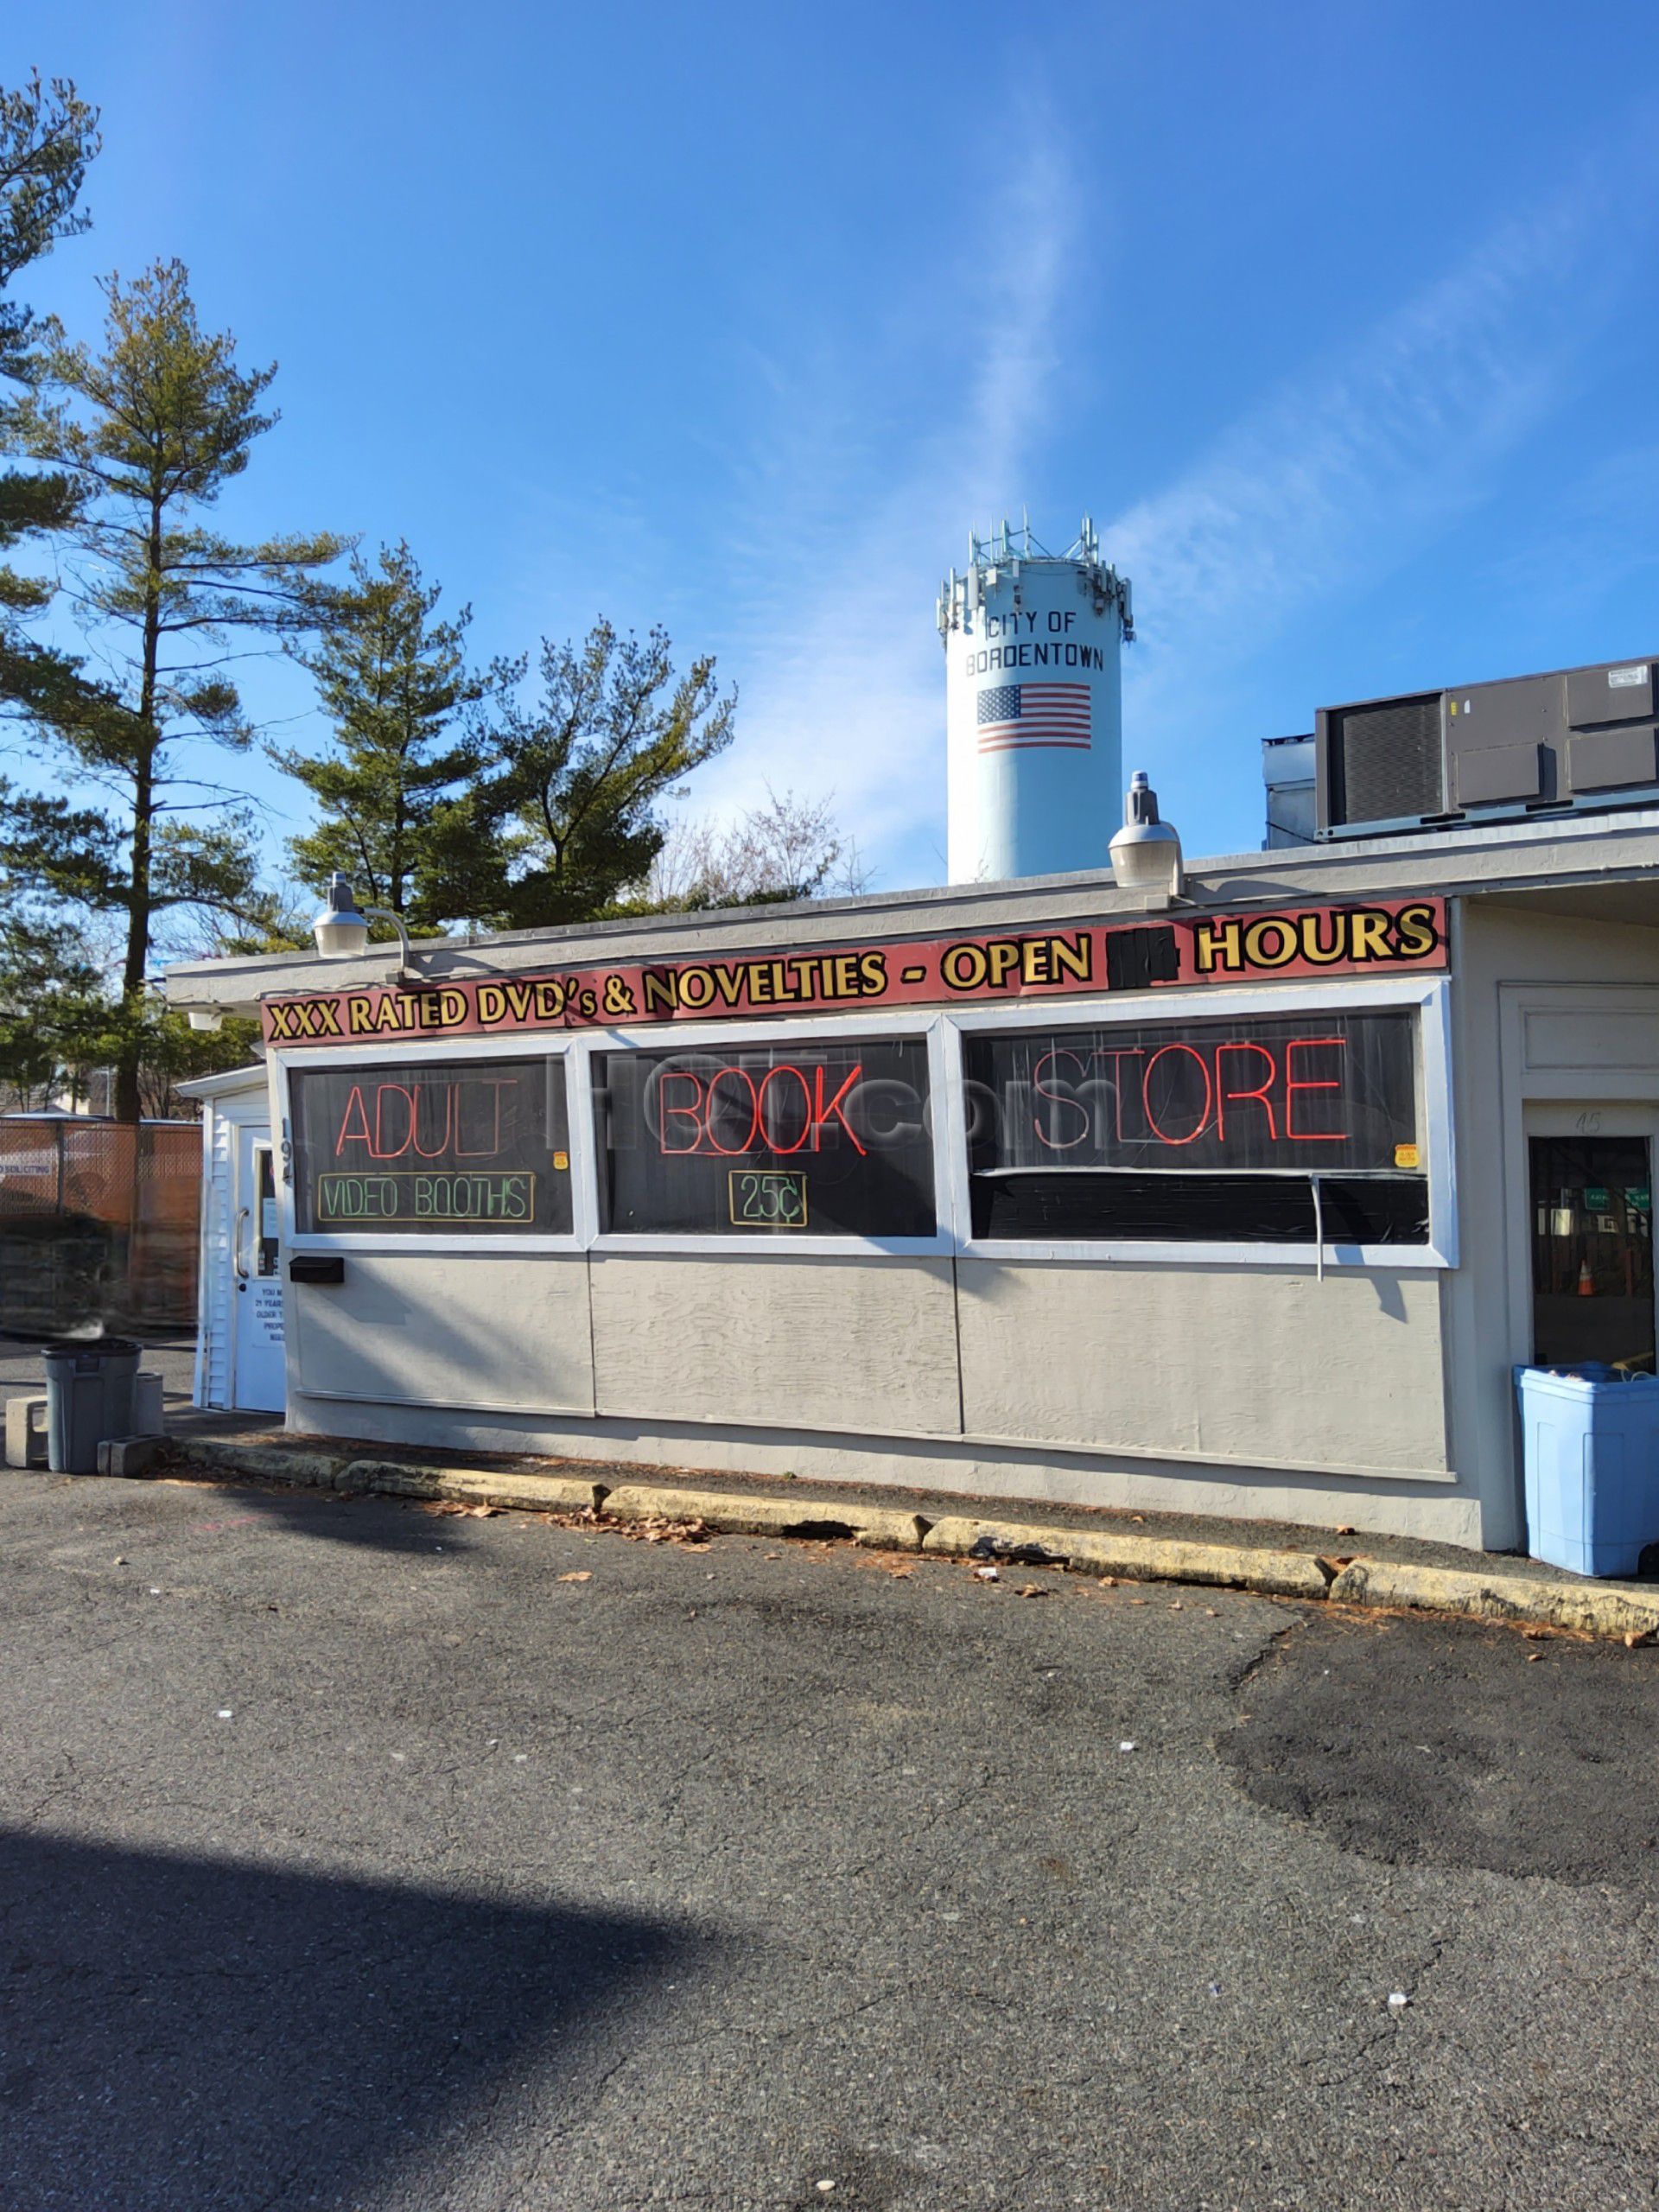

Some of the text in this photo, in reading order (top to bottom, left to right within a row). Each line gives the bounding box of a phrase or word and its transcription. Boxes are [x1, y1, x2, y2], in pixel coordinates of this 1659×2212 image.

[988, 610, 1077, 638] CITY OF
[966, 642, 1103, 677] BORDENTOWN
[268, 1000, 344, 1041] XXX
[348, 987, 468, 1034] RATED
[476, 978, 597, 1025] DVD's
[603, 975, 637, 1015] &
[642, 950, 887, 1013] NOVELTIES
[940, 933, 1091, 990] OPEN
[1194, 904, 1438, 973] HOURS
[335, 1039, 1348, 1159] ADULT BOOK STORE
[322, 1176, 528, 1217] VIDEO BOOTHS
[741, 1174, 801, 1224] 25¢
